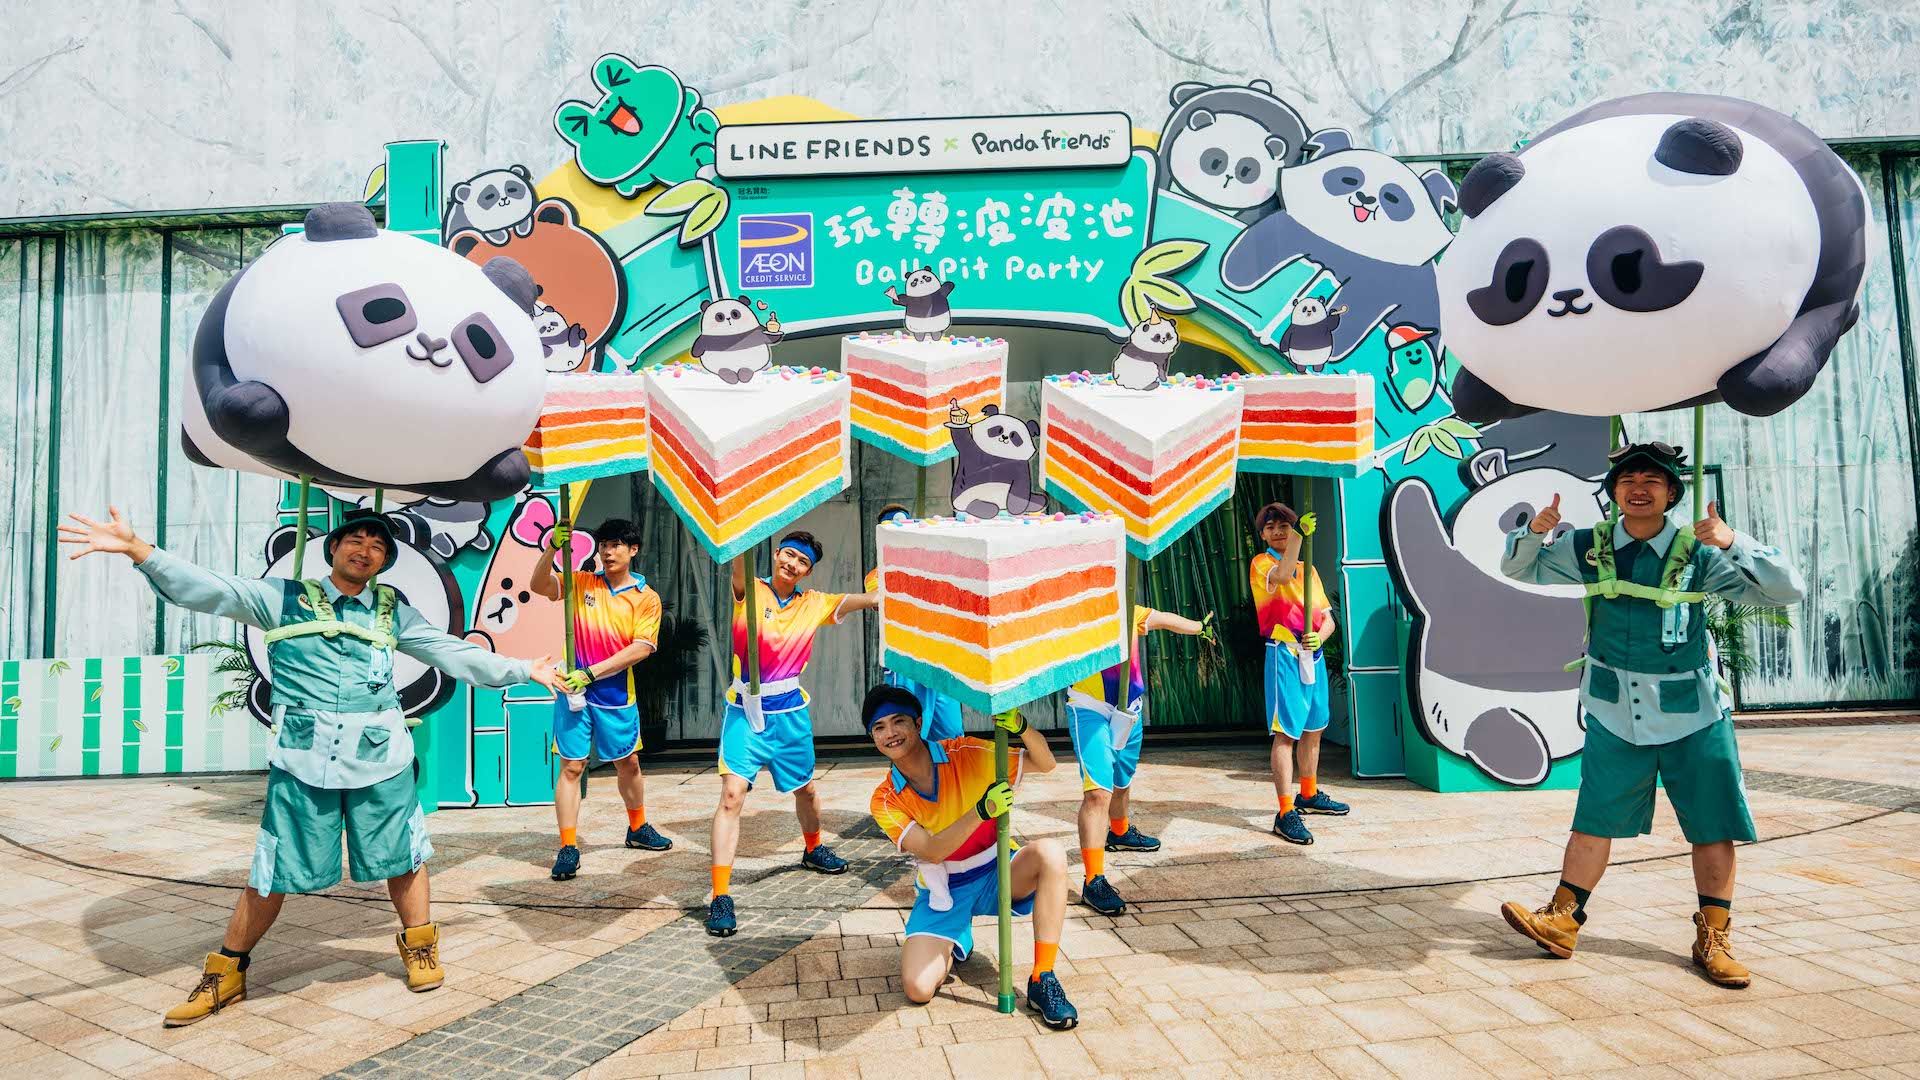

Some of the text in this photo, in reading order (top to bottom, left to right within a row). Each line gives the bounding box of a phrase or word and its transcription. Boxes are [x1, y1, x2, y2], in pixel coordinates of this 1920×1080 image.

[730, 141, 797, 161] LINE
[806, 135, 931, 159] FRIENDS
[823, 187, 1134, 254] 玩轉波波池
[745, 273, 807, 283] CREDIT SERVICE
[938, 255, 989, 281] Pit
[1005, 254, 1105, 283] Party
